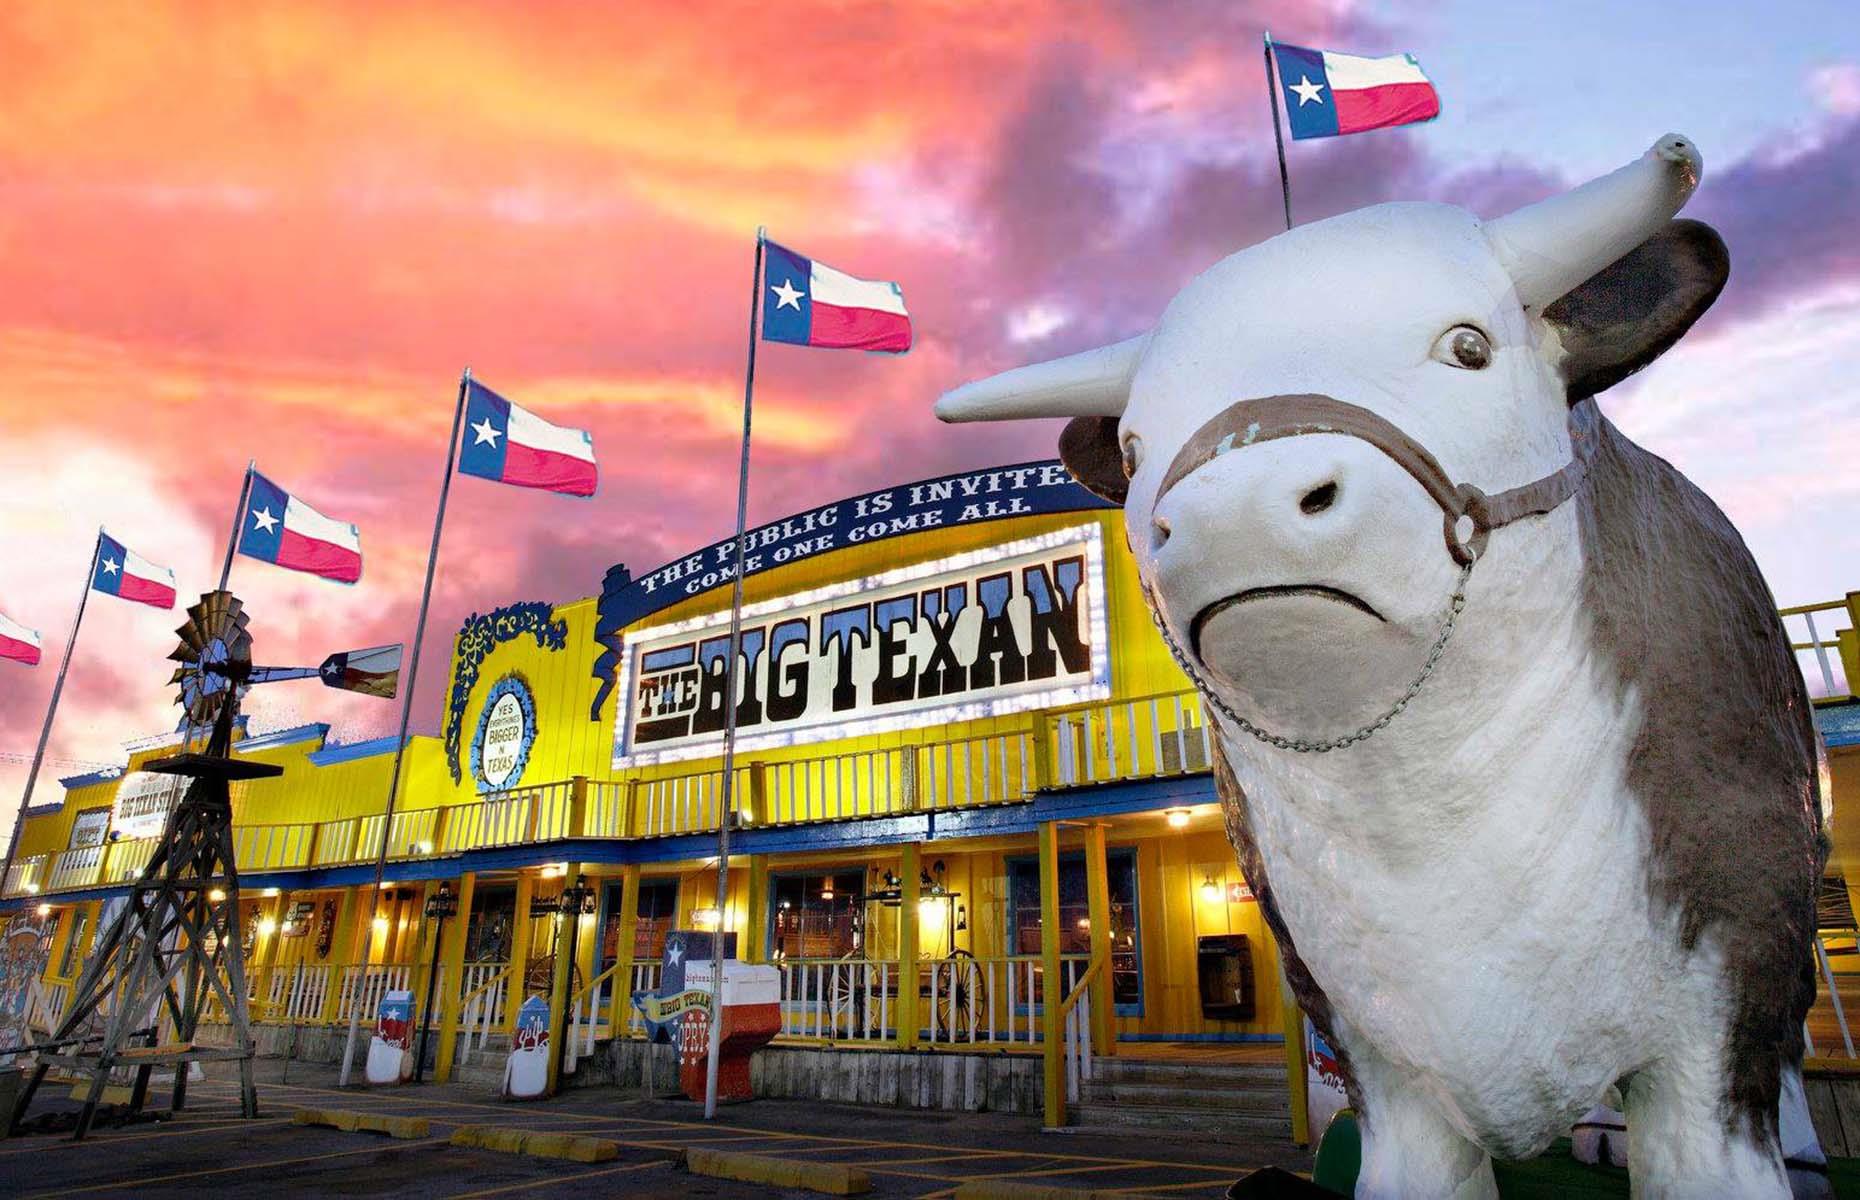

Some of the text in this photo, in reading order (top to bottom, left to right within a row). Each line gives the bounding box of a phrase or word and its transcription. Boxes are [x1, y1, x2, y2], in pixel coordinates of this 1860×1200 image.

[641, 465, 1077, 593] THE PUBLIC IS INVITE
[685, 498, 1031, 594] COME ONE COME ALL
[639, 554, 1090, 734] THE BIG TEXAN
[498, 703, 513, 716] YES
[488, 726, 519, 745] BIGGER
[487, 755, 513, 773] TEXAS
[678, 1022, 707, 1052] OPRY
